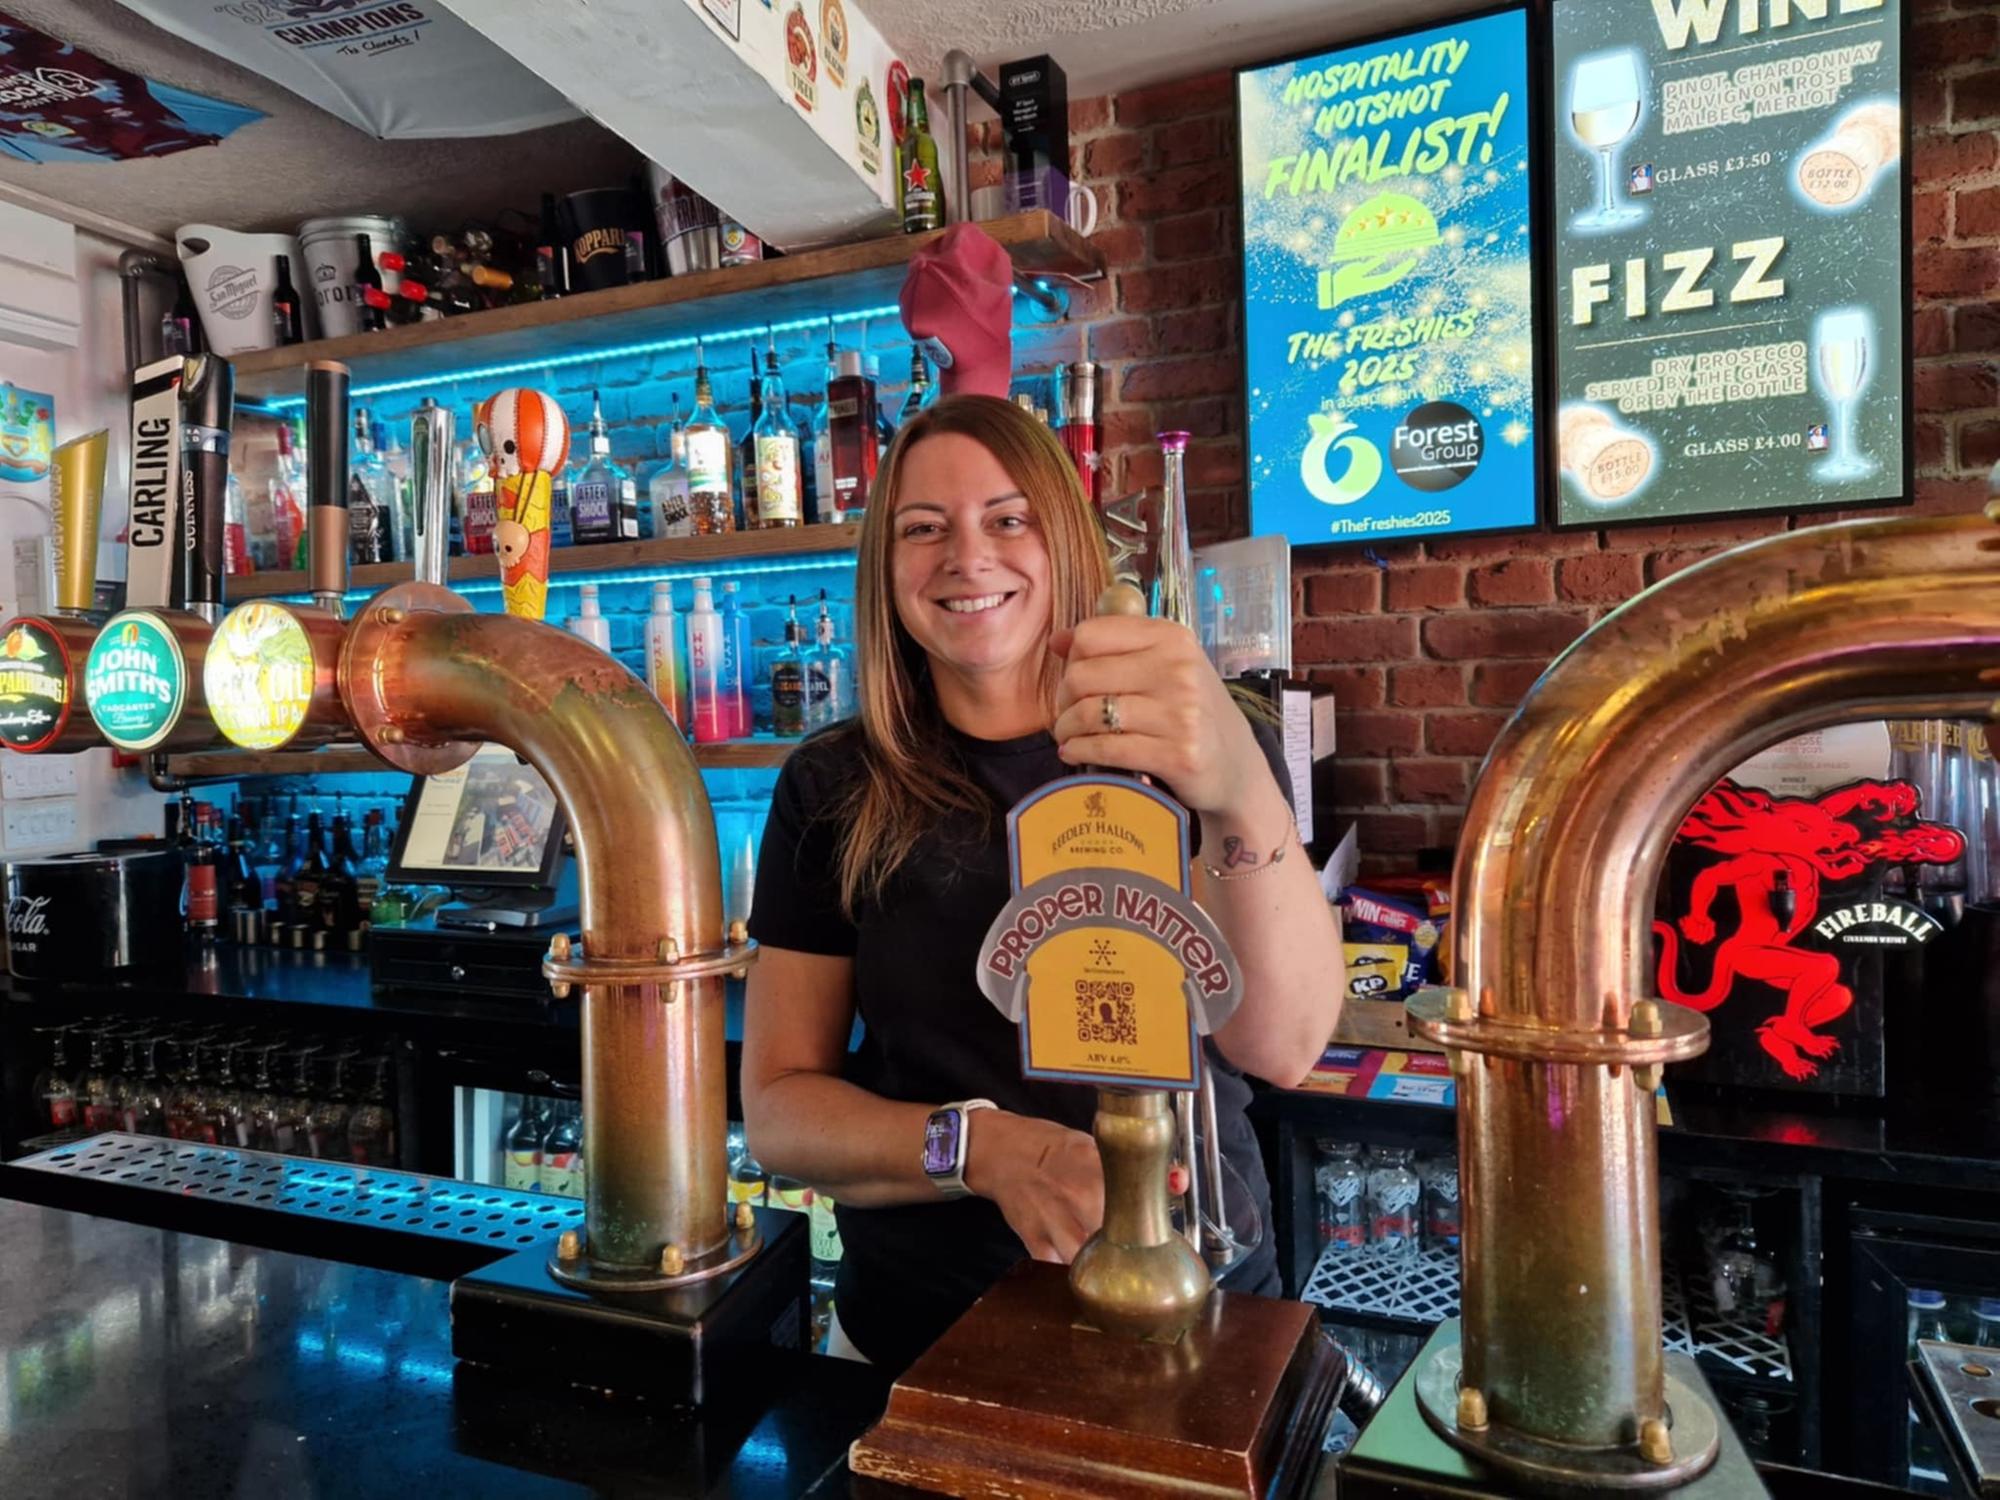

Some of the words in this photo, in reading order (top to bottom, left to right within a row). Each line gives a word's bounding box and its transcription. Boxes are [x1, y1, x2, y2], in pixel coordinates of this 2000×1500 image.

[274, 2, 425, 46] CHAMPIONS
[1651, 0, 1883, 50] WIN
[1283, 38, 1469, 105] HOSPITALITY
[1665, 73, 1732, 99] PINOT,
[1735, 45, 1881, 85] CHARDONNAY
[1796, 68, 1850, 91] ROSE
[1315, 79, 1451, 134] HOTSHOT
[1665, 106, 1751, 133] MALBEC,
[1756, 87, 1837, 116] MERLOT
[1265, 92, 1509, 200] FINALIST!
[1655, 161, 1719, 184] GLASS
[1724, 151, 1771, 173] £3.50
[1572, 236, 1786, 326] FIZZ
[1288, 331, 1342, 364] THE
[1346, 307, 1479, 353] FRESHIES
[1338, 353, 1420, 390] 2025
[1654, 358, 1692, 375] DRY
[1698, 343, 1805, 369] PROSECCO
[1588, 378, 1659, 399] SERVED
[1665, 374, 1690, 391] BY
[1696, 368, 1734, 385] THE
[1740, 360, 1805, 381] GLASS
[1621, 395, 1649, 412] OR
[1654, 392, 1678, 408] BY
[1686, 386, 1722, 402] THE
[1728, 376, 1805, 399] BOTTLE
[1395, 419, 1479, 449] Forest
[1421, 442, 1479, 463] Group
[1684, 438, 1749, 457] GLASS
[1754, 432, 1801, 451] £4.00
[131, 417, 171, 548] CARLING
[577, 484, 608, 501] AFTER
[578, 501, 609, 519] SHOCK
[1331, 510, 1451, 534] #TheFreshies2025
[96, 648, 158, 675] JOHN
[86, 670, 171, 708] SMITH'S
[988, 884, 1106, 980] PROPER
[1112, 884, 1232, 998] NATTER
[1814, 902, 1934, 942] FIREBALL
[1352, 975, 1385, 995] KP
